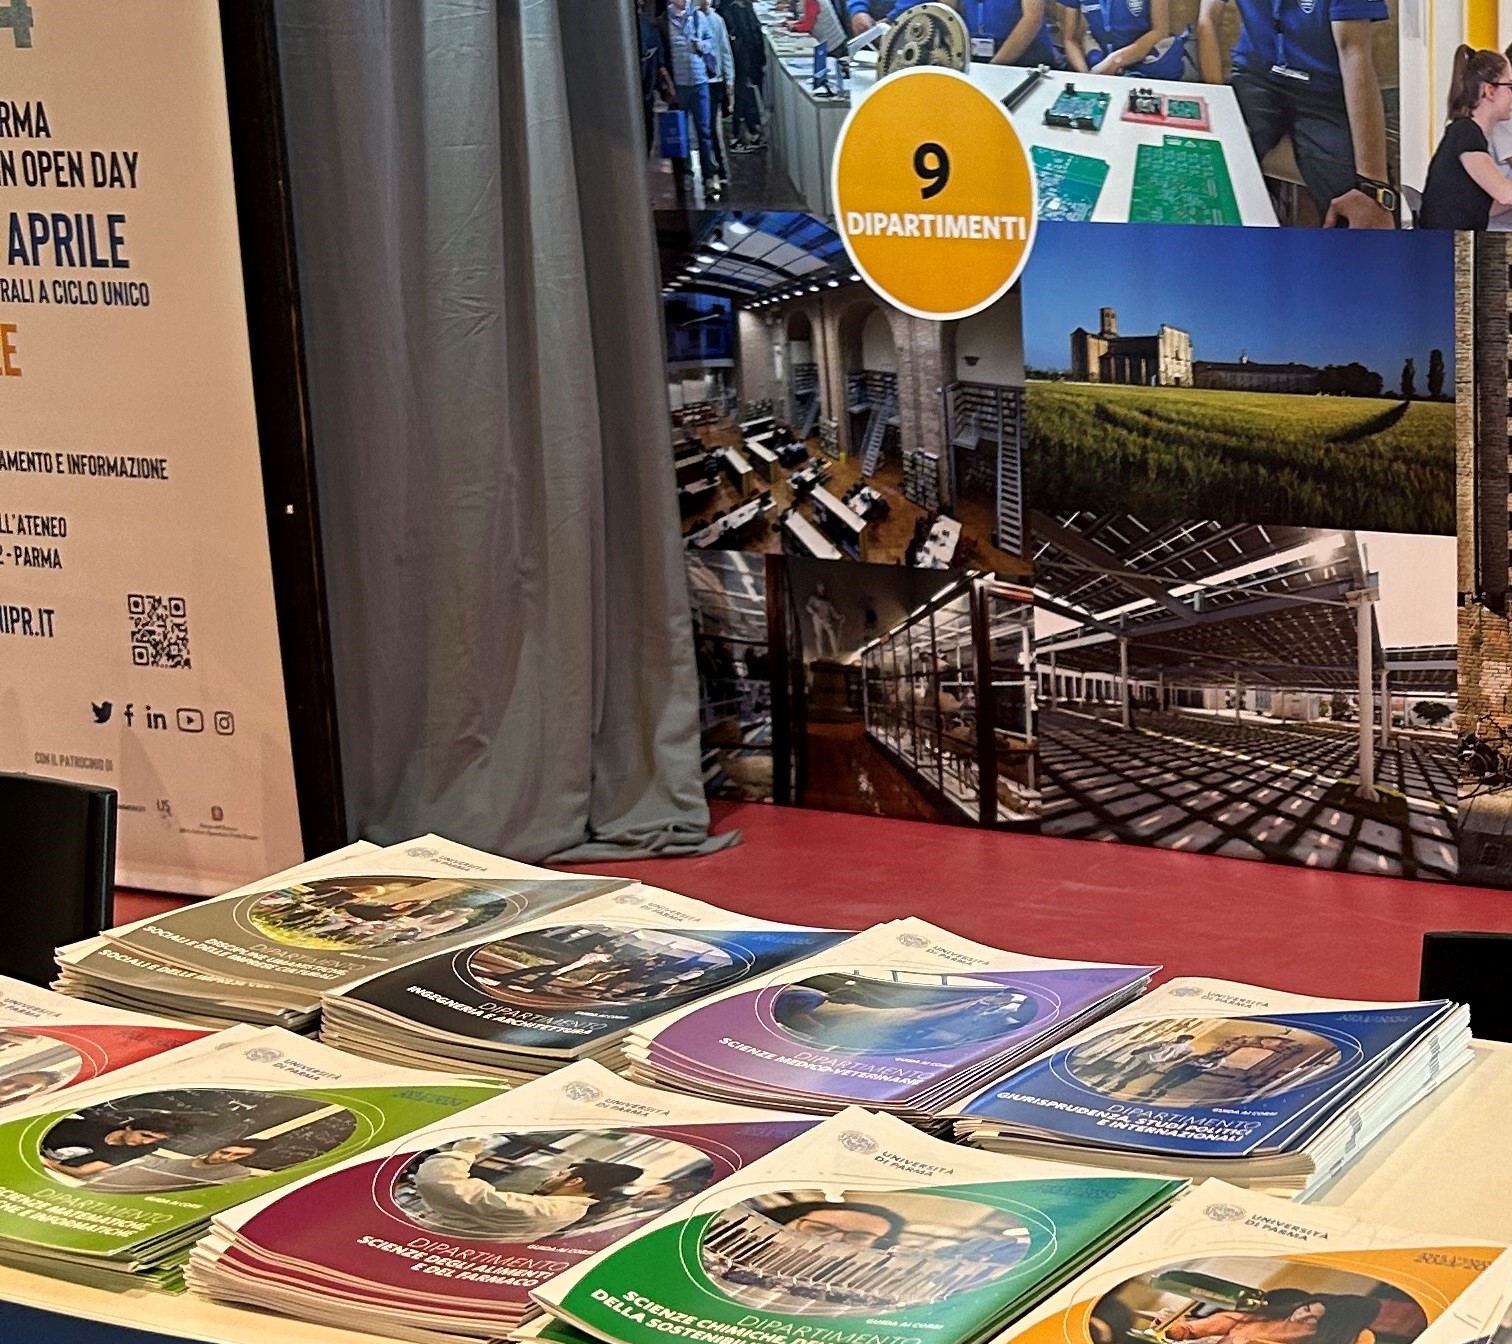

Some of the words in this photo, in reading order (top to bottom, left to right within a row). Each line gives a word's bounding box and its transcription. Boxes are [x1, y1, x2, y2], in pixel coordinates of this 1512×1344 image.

[22, 150, 85, 187] OPEN
[90, 151, 139, 188] DAY
[913, 142, 951, 200] 9
[8, 211, 130, 269] APRILE
[846, 211, 1027, 241] DIPARTIMENTI
[39, 279, 50, 304] A
[52, 280, 98, 305] CICLO
[101, 281, 150, 307] UNICO
[55, 453, 65, 474] E
[67, 454, 169, 480] INFORMAZIONE
[13, 545, 63, 569] PARMA
[406, 985, 481, 1017] INGEGNERIA
[493, 1015, 594, 1035] ARCHITETTURA
[478, 1001, 608, 1031] DIPARTIMENTO
[719, 1037, 779, 1060] SCIENZE
[796, 1050, 935, 1080] DIPARTIMENTO
[1096, 1118, 1111, 1127] E
[1109, 1121, 1245, 1143] INTERNAZIONALI
[1106, 1103, 1262, 1130] DIPARTIMENTO
[1133, 1117, 1184, 1131] STUDI
[1179, 1122, 1253, 1137] POLITICI
[890, 1160, 934, 1177] PARMA
[32, 1188, 174, 1224] DIPARTIMENTO
[1244, 1218, 1260, 1228] DI
[1261, 1223, 1308, 1241] PARMA
[356, 1235, 427, 1260] SCIENZE
[424, 1254, 472, 1270] DEGLI
[471, 1262, 555, 1280] ALIMENTI
[406, 1237, 570, 1272] DIPARTIMENTO
[410, 1262, 426, 1272] E
[424, 1265, 453, 1278] DEL
[454, 1270, 540, 1287] FARMACO
[590, 1288, 645, 1324] DELLA
[622, 1290, 700, 1326] SCIENZE
